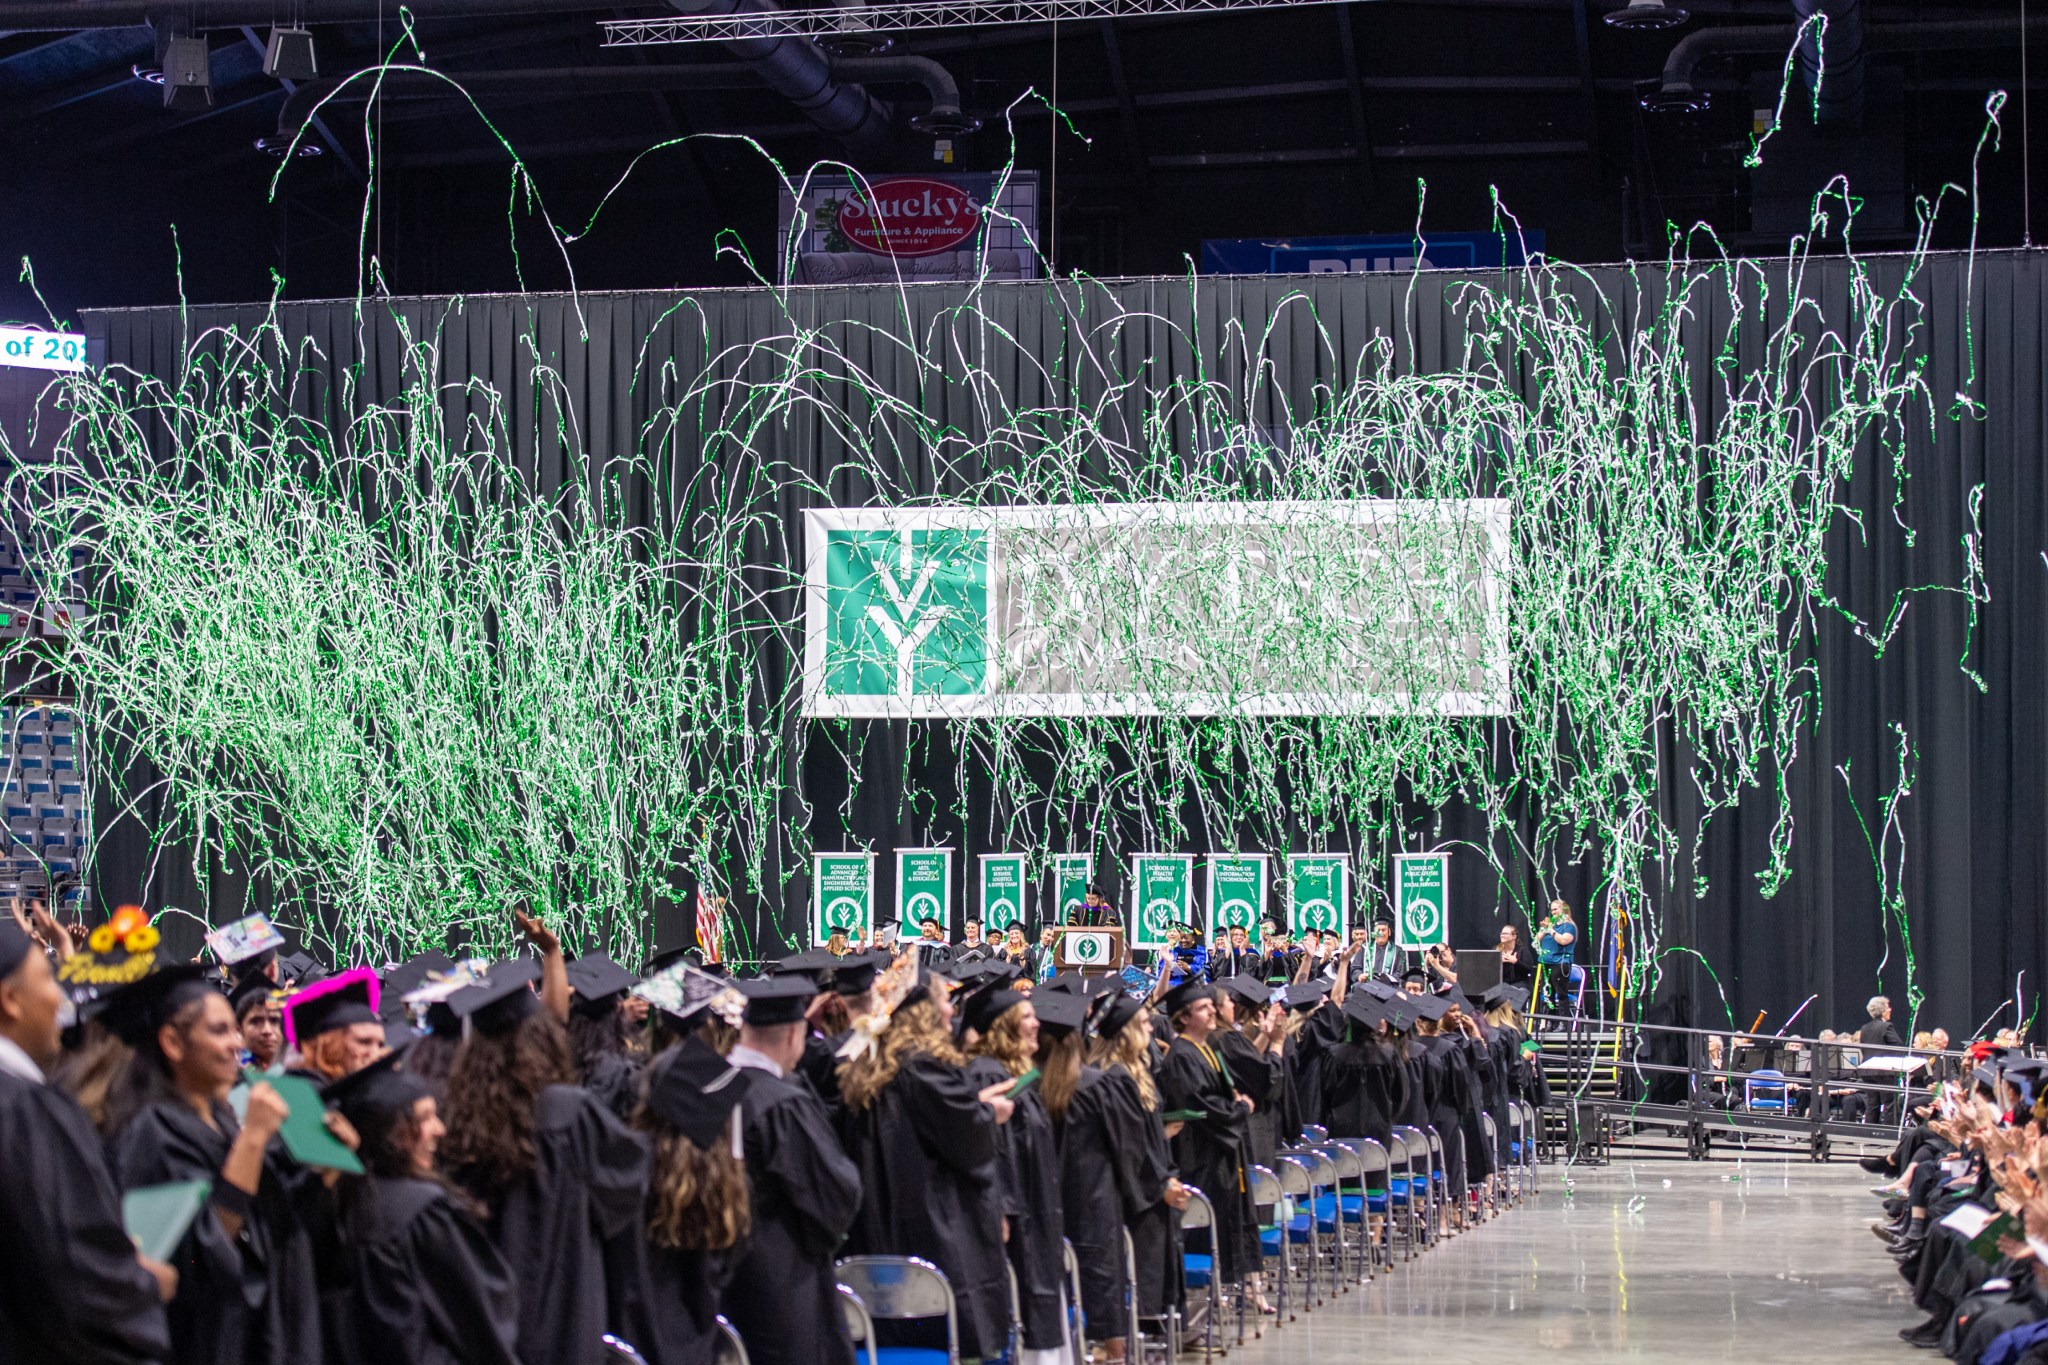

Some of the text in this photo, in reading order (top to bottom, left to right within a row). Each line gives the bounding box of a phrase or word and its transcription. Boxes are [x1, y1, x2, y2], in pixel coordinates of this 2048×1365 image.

[843, 189, 981, 225] Stucky's
[903, 226, 911, 235] &
[914, 226, 963, 237] Appliance
[5, 335, 35, 357] of
